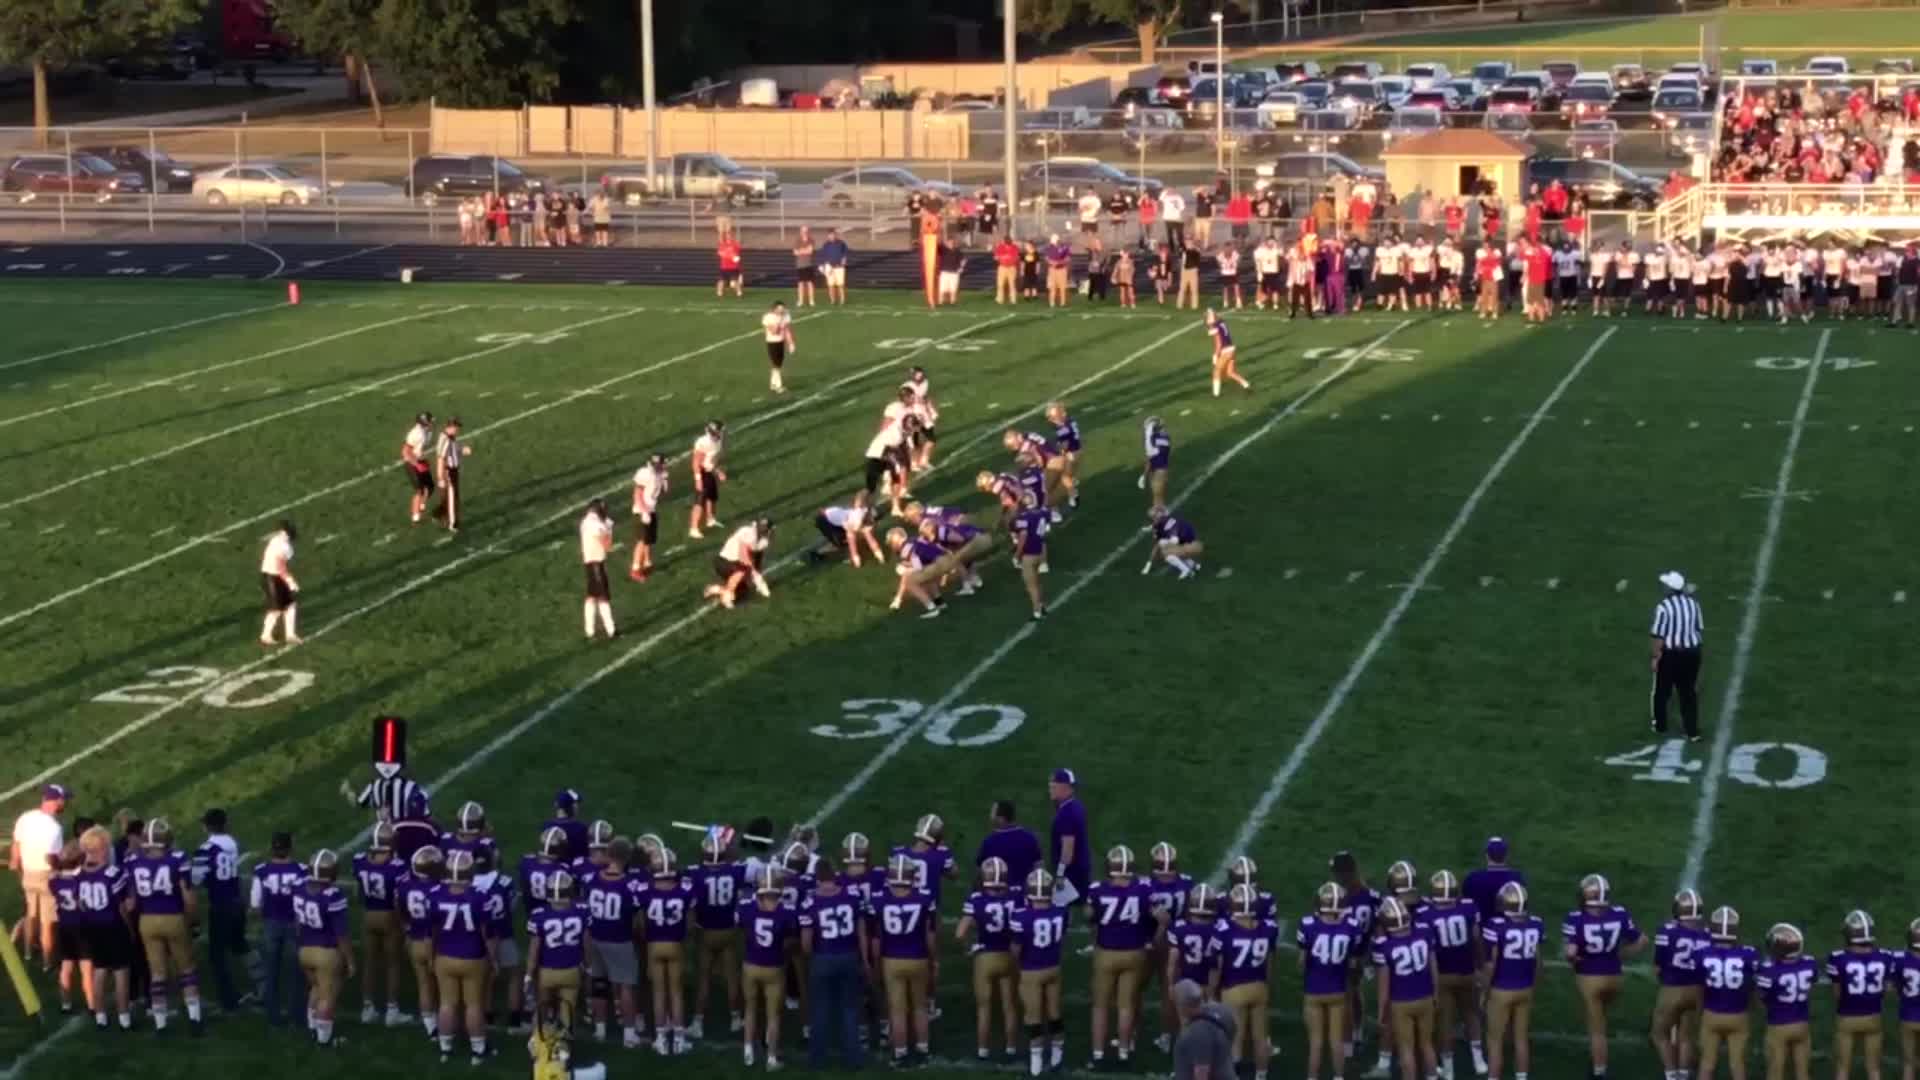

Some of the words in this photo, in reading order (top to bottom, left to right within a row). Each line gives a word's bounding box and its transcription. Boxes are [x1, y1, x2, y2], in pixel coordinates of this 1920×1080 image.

[91, 665, 315, 709] 20
[808, 698, 1027, 747] 30
[1604, 738, 1828, 789] 40
[133, 865, 174, 897] 64
[358, 870, 387, 899] 13
[704, 875, 735, 906] 18
[292, 895, 324, 929] 59
[438, 902, 475, 932] 71
[588, 888, 622, 921] 60
[647, 898, 685, 927] 43
[817, 903, 854, 939] 53
[882, 903, 922, 935] 67
[1099, 895, 1140, 926] 74
[543, 916, 582, 949] 22
[754, 917, 775, 948] 5
[1032, 915, 1064, 949] 81
[1433, 914, 1468, 948] 10
[1502, 928, 1540, 960] 28
[1583, 921, 1622, 954] 57
[1231, 937, 1270, 968] 79
[1311, 933, 1350, 965] 40
[1391, 939, 1429, 976] 20
[1703, 957, 1744, 990] 36
[1777, 969, 1814, 1004] 35
[1845, 961, 1886, 995] 33
